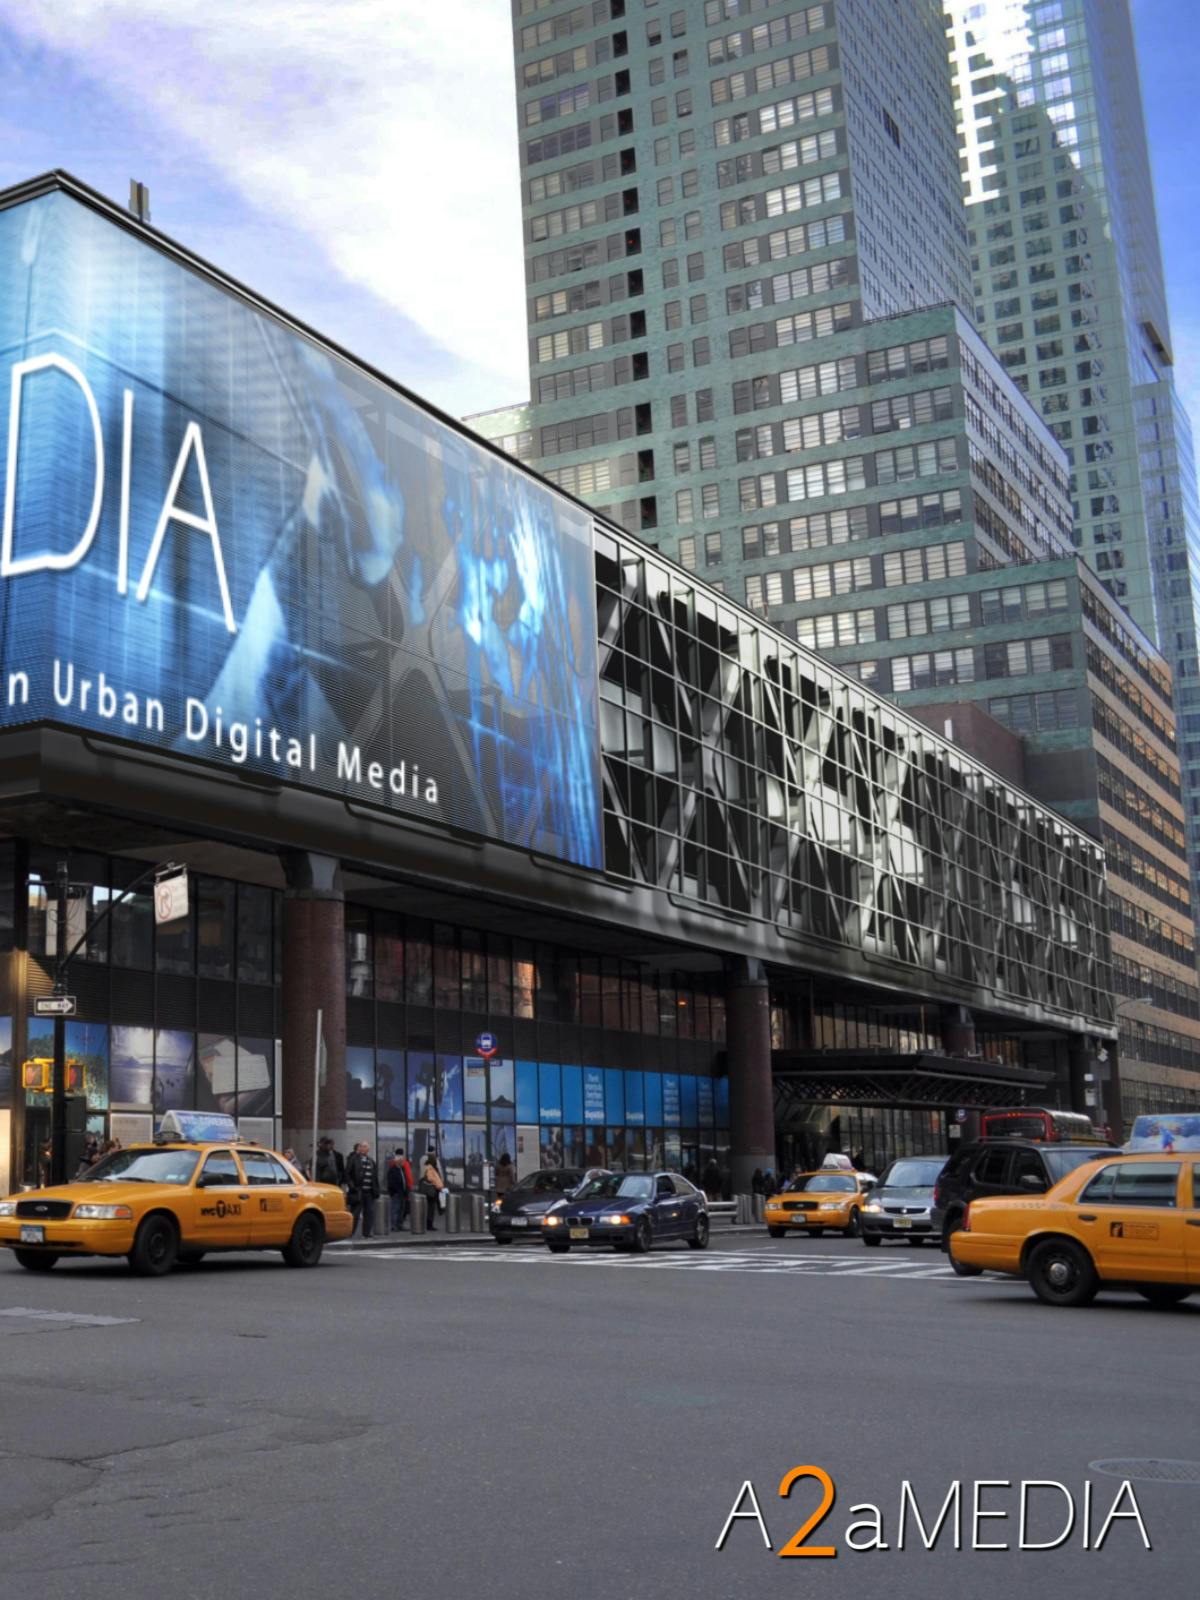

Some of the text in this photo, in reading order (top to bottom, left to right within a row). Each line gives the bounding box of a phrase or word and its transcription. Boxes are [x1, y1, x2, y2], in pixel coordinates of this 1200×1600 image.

[53, 659, 164, 732] Urban
[186, 697, 316, 772] Digital
[337, 742, 439, 804] Media
